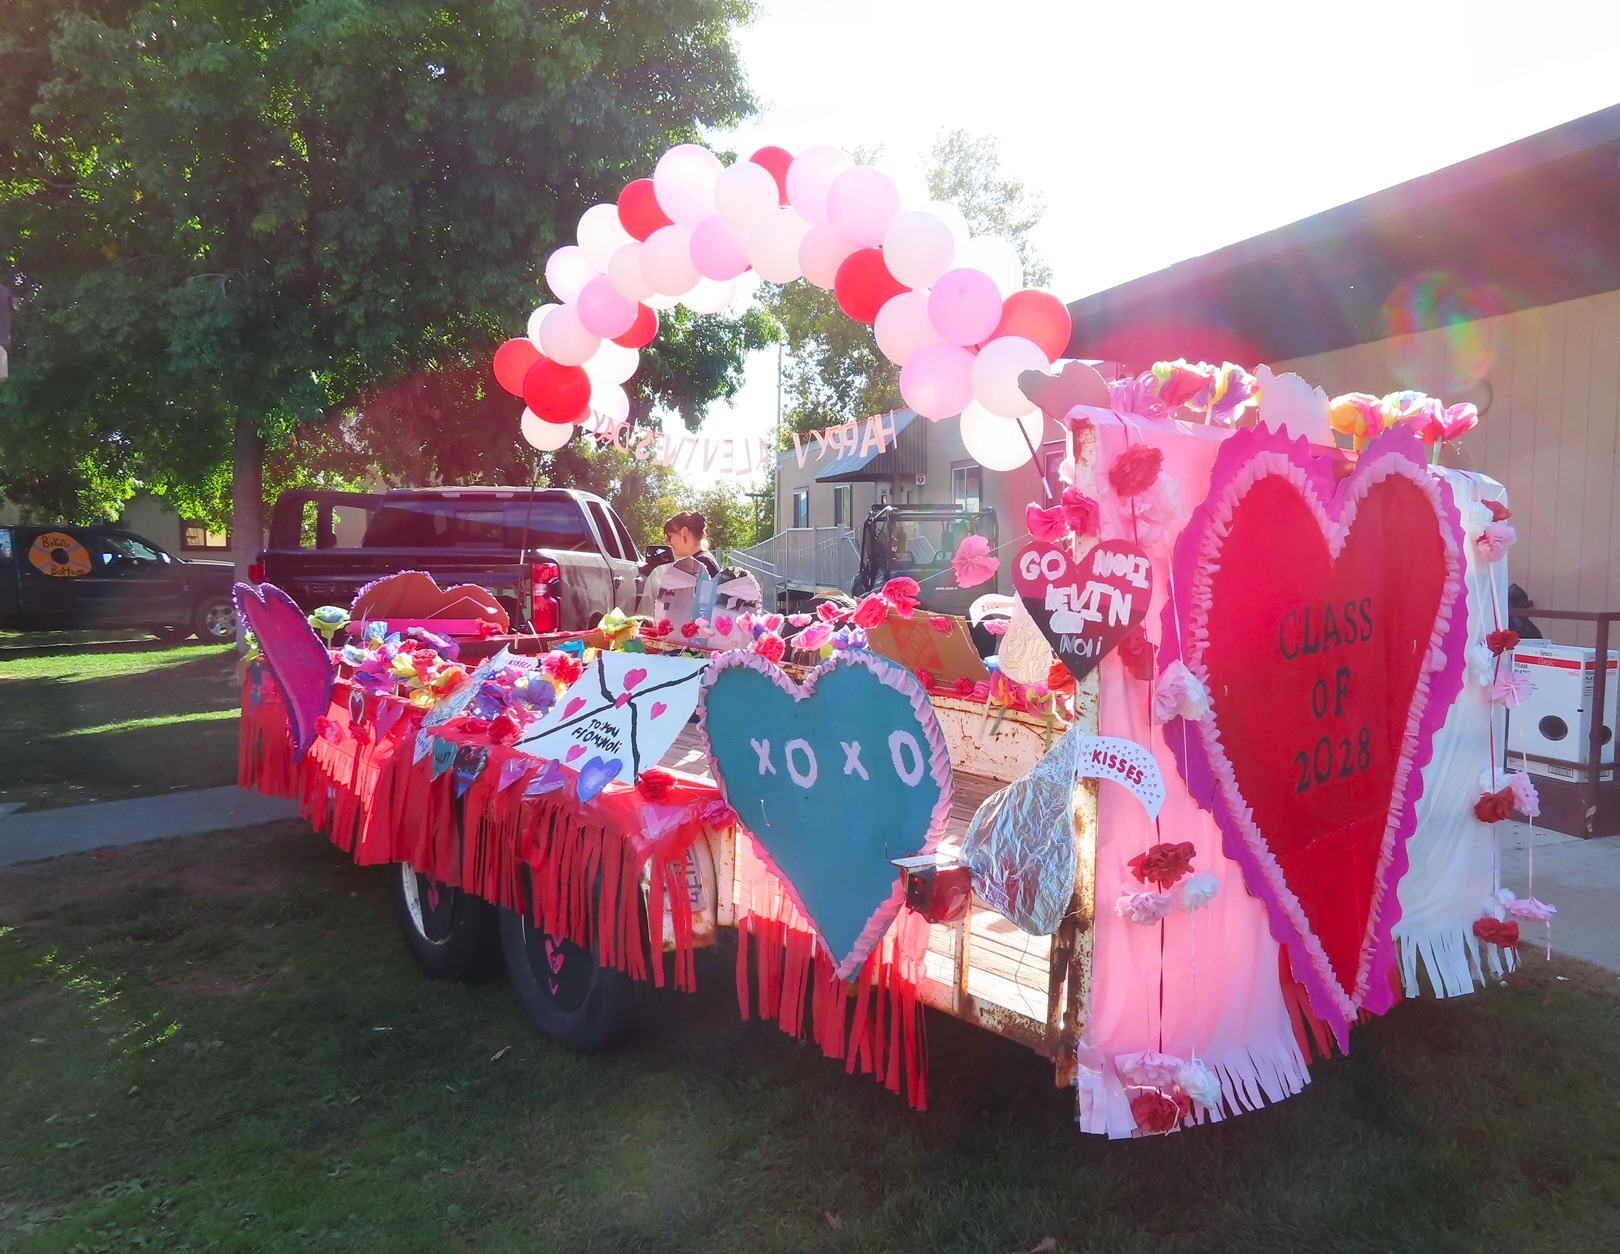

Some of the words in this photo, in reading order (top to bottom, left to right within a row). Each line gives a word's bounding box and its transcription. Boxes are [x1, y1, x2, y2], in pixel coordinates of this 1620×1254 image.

[1019, 550, 1067, 581] GO
[1044, 581, 1133, 627] KEVIN
[1278, 597, 1374, 661] CLASS
[1312, 666, 1351, 718] OF
[1091, 748, 1145, 785] KISSES
[1295, 725, 1371, 795] 2028
